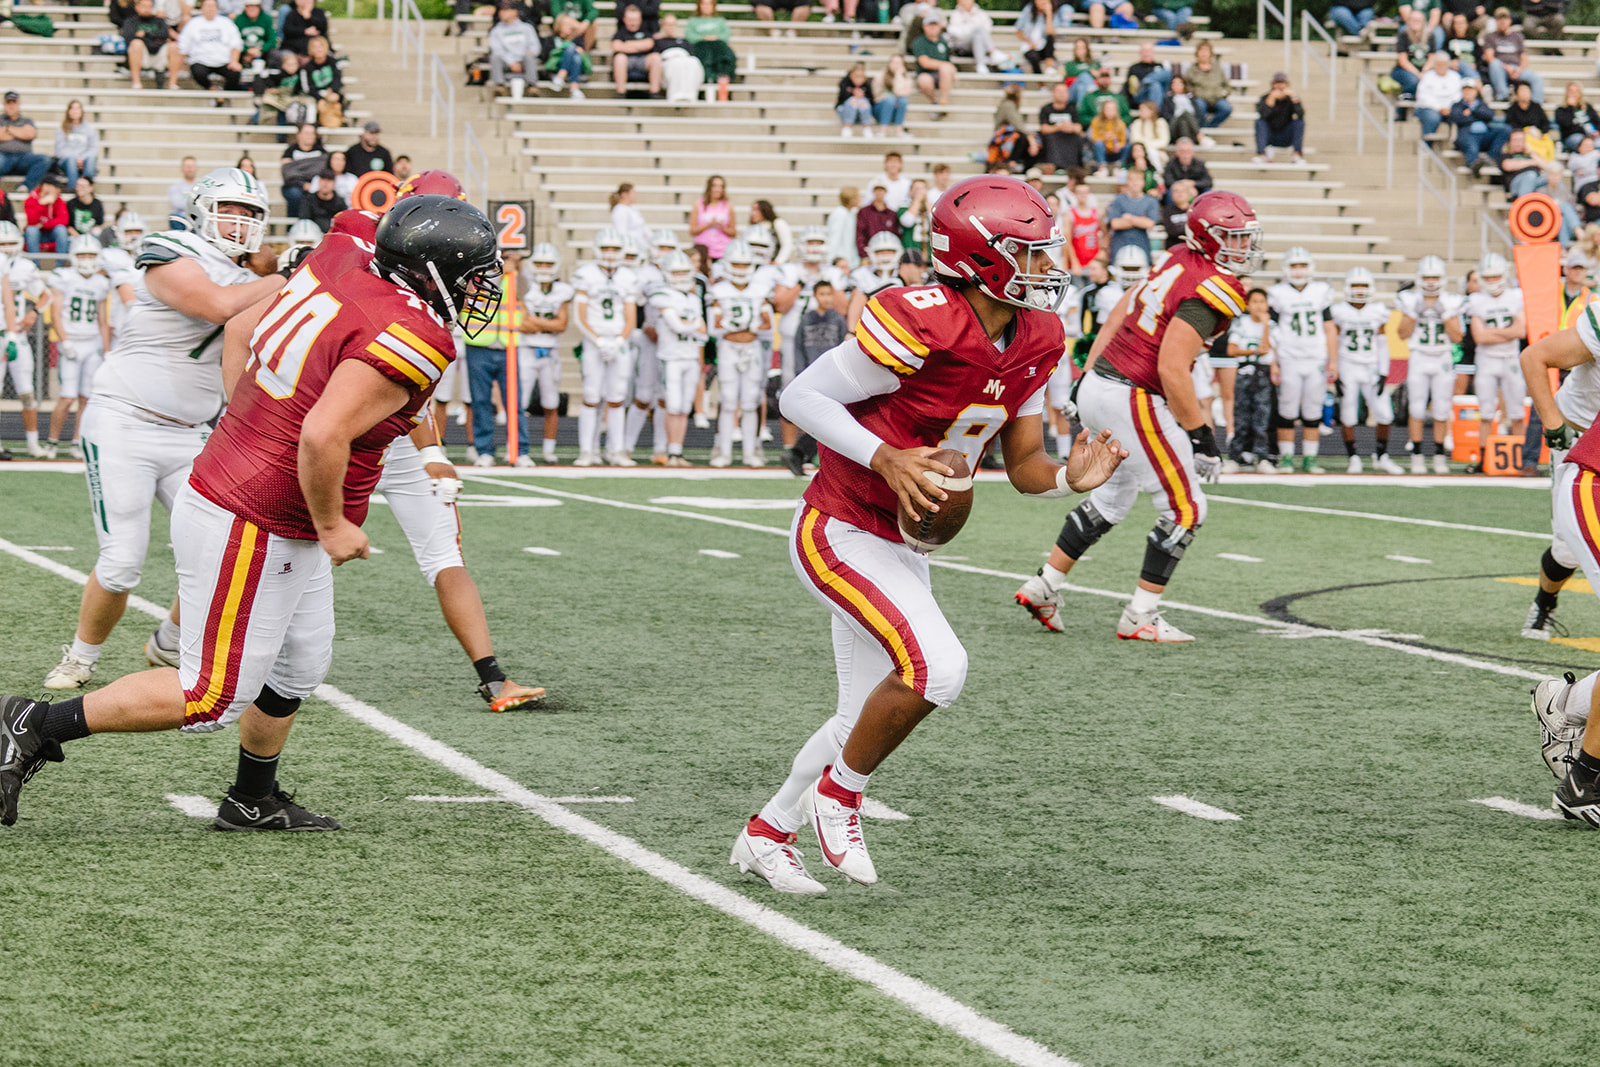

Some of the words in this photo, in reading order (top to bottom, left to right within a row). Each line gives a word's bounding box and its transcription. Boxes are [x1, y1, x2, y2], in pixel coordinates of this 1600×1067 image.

[497, 204, 526, 248] 2
[601, 298, 614, 320] 9
[902, 287, 948, 310] 8
[246, 263, 344, 400] 70
[1290, 311, 1316, 336] 45
[1345, 328, 1374, 351] 33
[982, 378, 1006, 401] MV
[937, 403, 1009, 479] 8
[1494, 442, 1524, 471] 50
